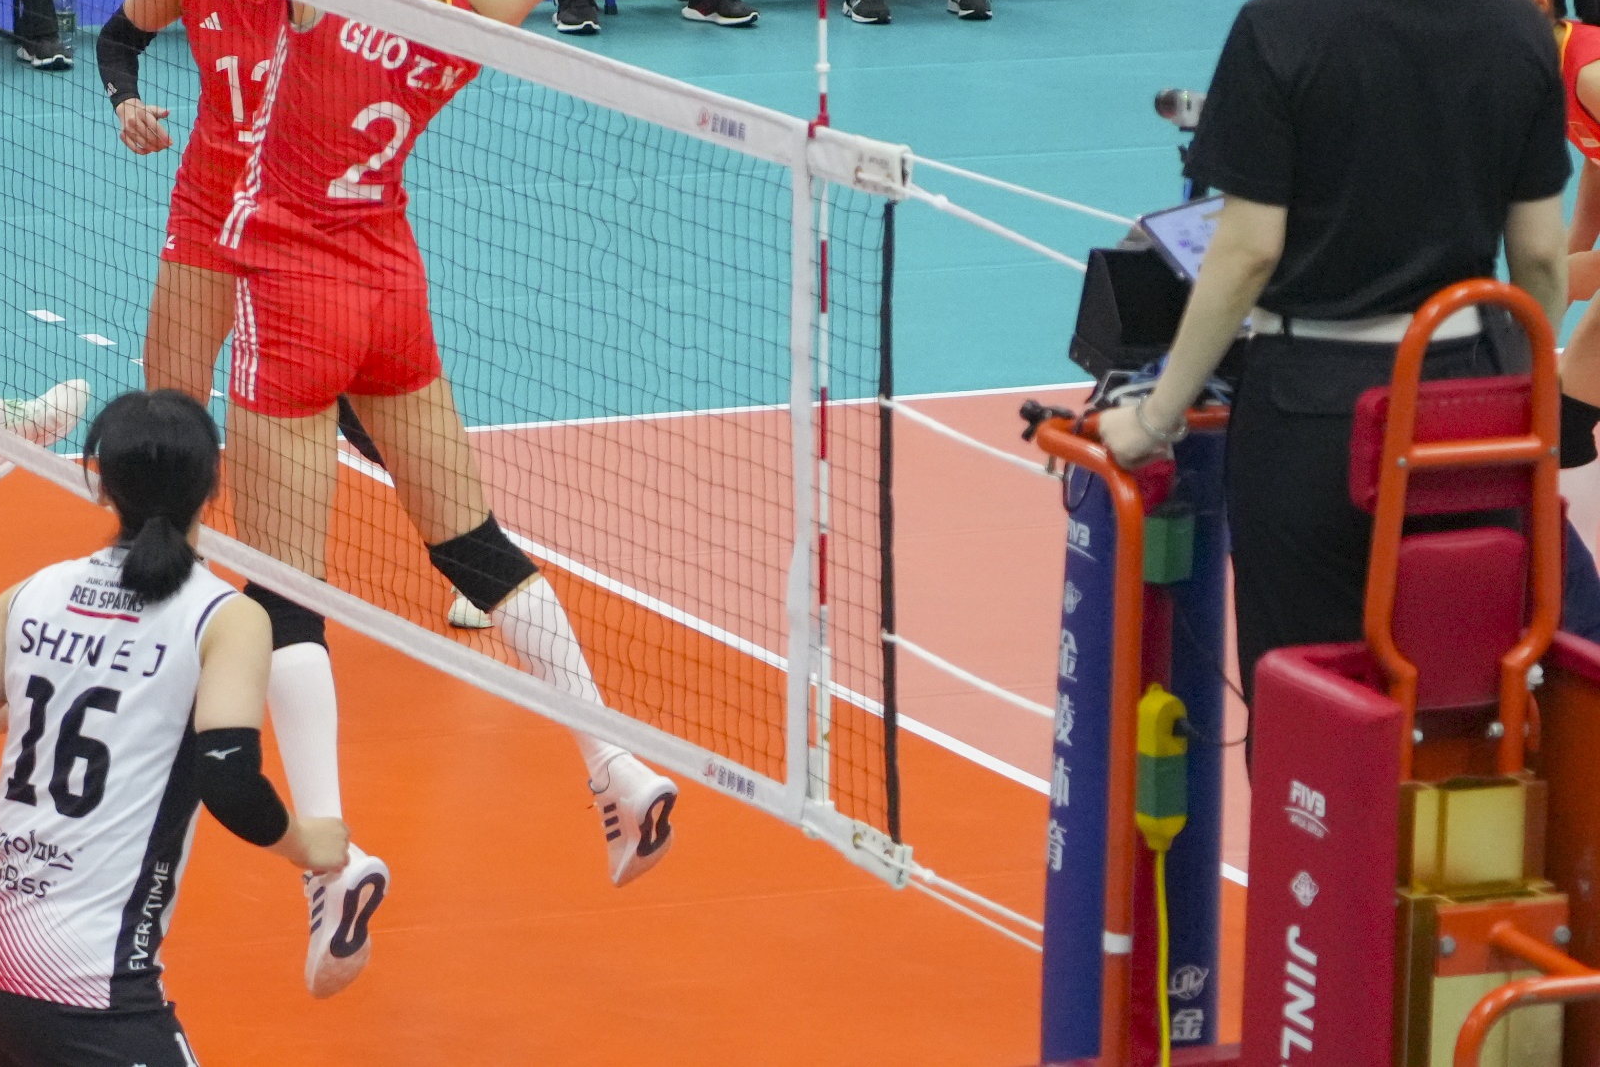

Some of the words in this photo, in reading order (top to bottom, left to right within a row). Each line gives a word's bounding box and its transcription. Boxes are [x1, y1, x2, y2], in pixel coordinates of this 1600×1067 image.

[340, 19, 408, 70] GUO
[326, 101, 411, 200] 2
[70, 584, 96, 607] RED
[98, 590, 146, 613] SPARKS
[19, 618, 106, 667] SHIN
[142, 643, 168, 677] J
[4, 674, 122, 819] 16
[1290, 780, 1326, 817] FIVB
[129, 860, 170, 972] EVERTIME
[1280, 924, 1319, 1067] JINL
